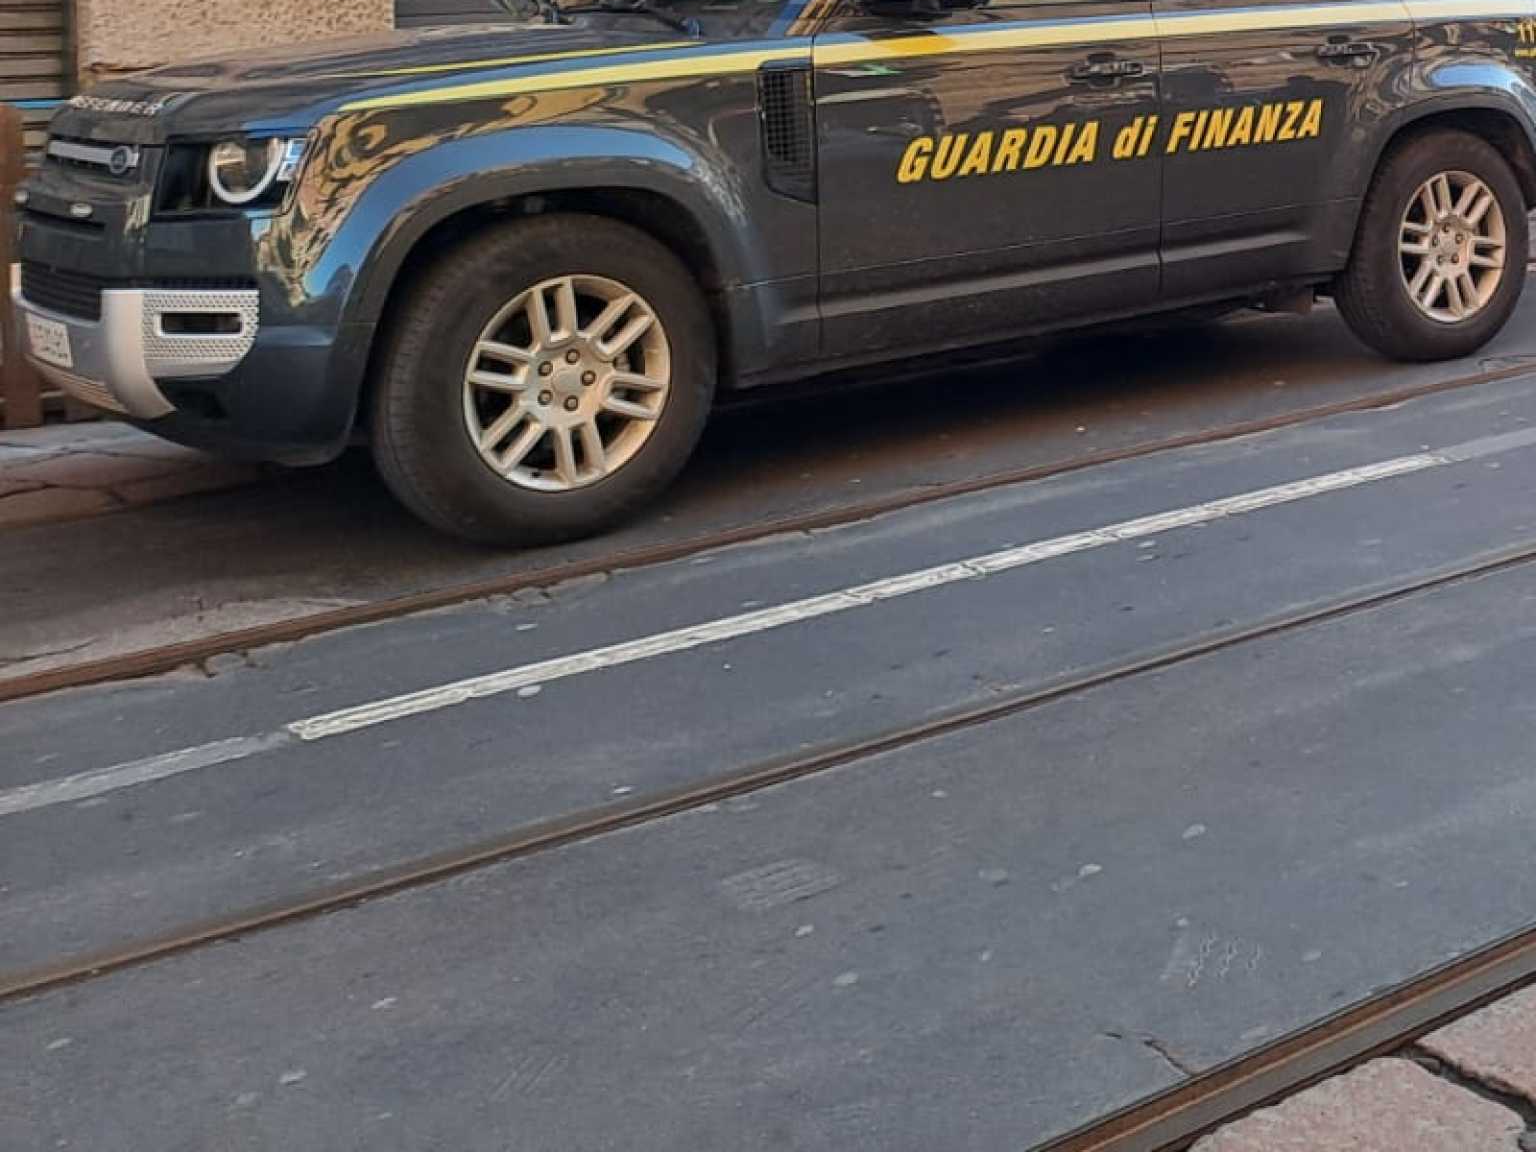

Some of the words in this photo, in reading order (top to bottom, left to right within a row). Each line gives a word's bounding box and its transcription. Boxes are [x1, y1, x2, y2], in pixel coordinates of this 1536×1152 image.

[898, 122, 1099, 183] GUARDIA
[1112, 115, 1159, 160] di
[1166, 99, 1324, 153] FINANZA
